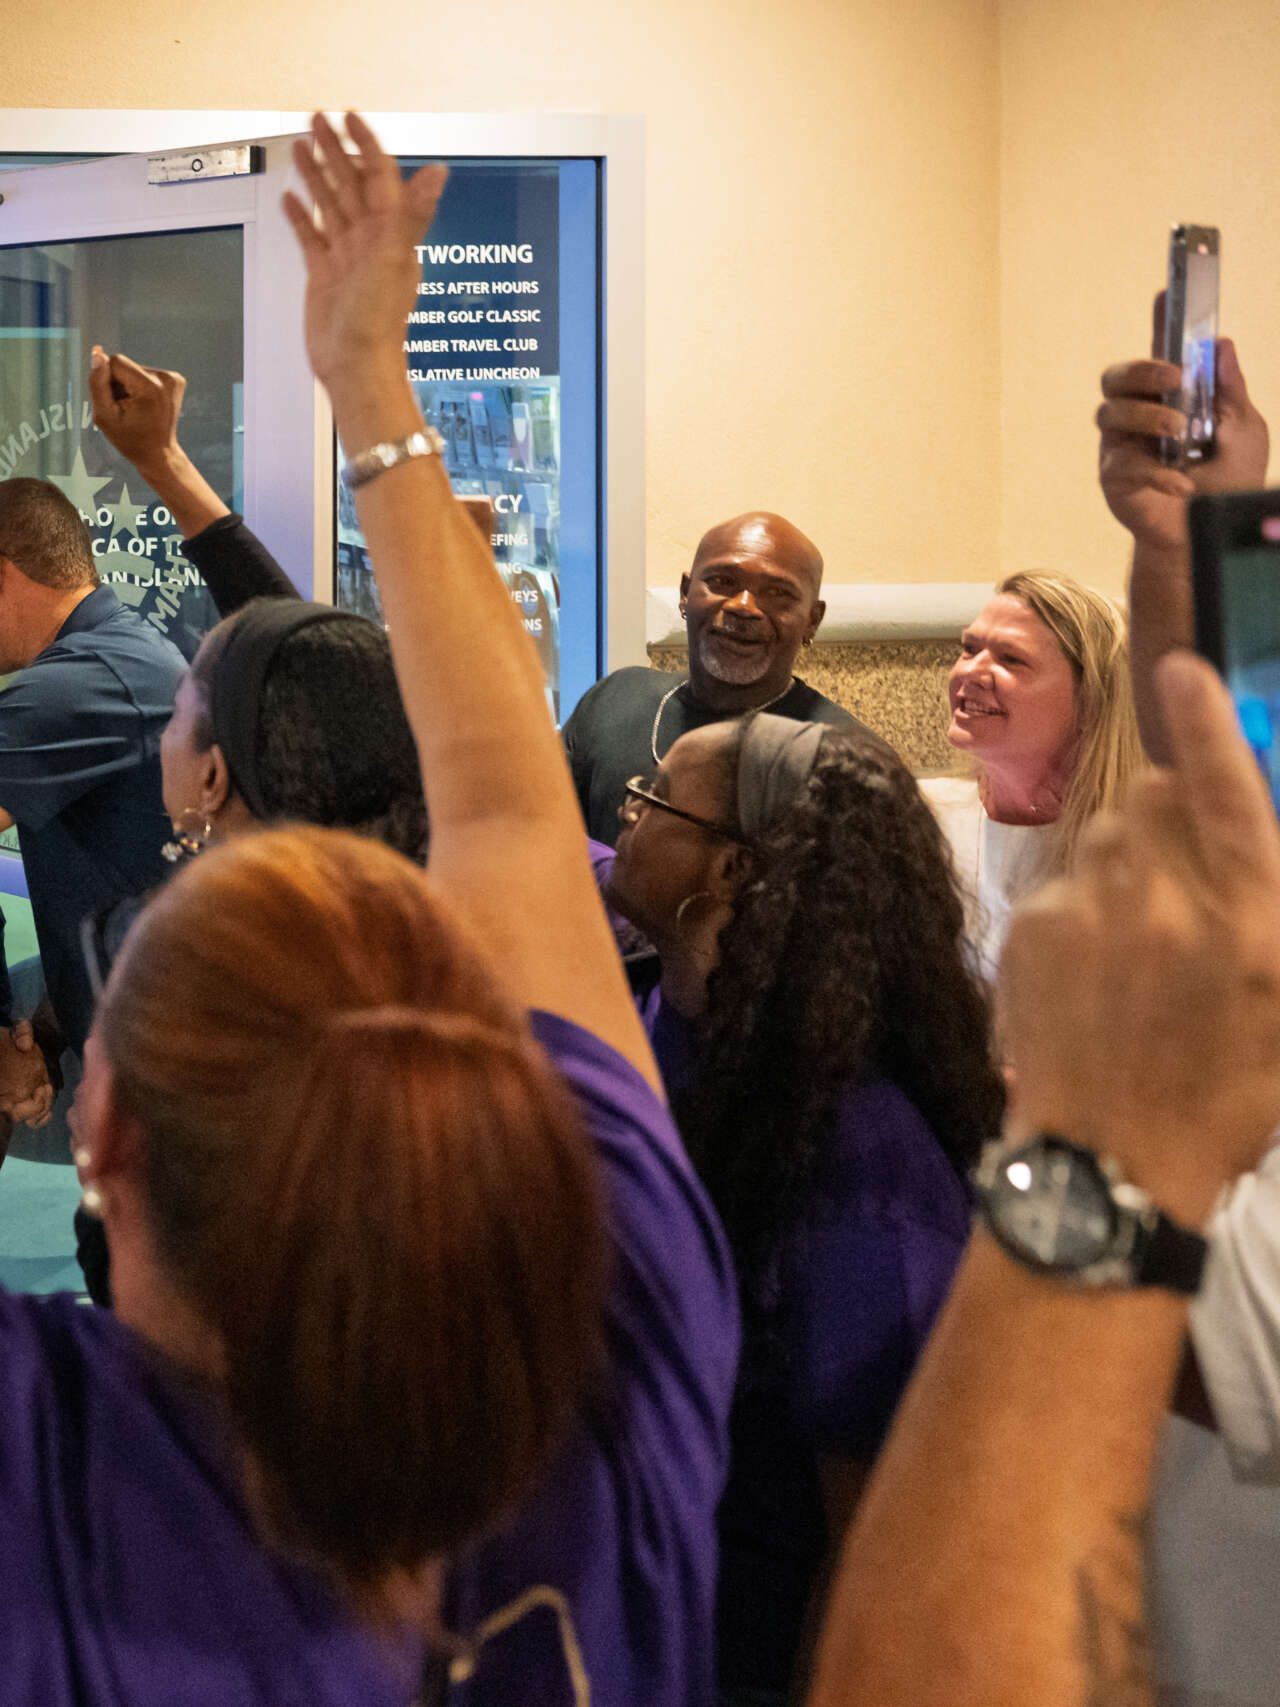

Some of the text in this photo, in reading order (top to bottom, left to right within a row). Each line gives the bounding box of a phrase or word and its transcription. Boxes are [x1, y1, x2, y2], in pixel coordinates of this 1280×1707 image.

[414, 244, 533, 264] TWORKING
[447, 281, 490, 295] AFTER
[492, 280, 539, 294] HOURS
[405, 309, 541, 324] MBER GOLF CLASSIC
[402, 338, 538, 353] AMBER TRAVEL CLUB
[407, 367, 540, 381] ISLATIVE LUNCHEON
[491, 494, 523, 514] CY
[152, 506, 176, 526] O
[127, 537, 158, 556] OF
[490, 534, 528, 546] EFING
[511, 590, 538, 603] EYS
